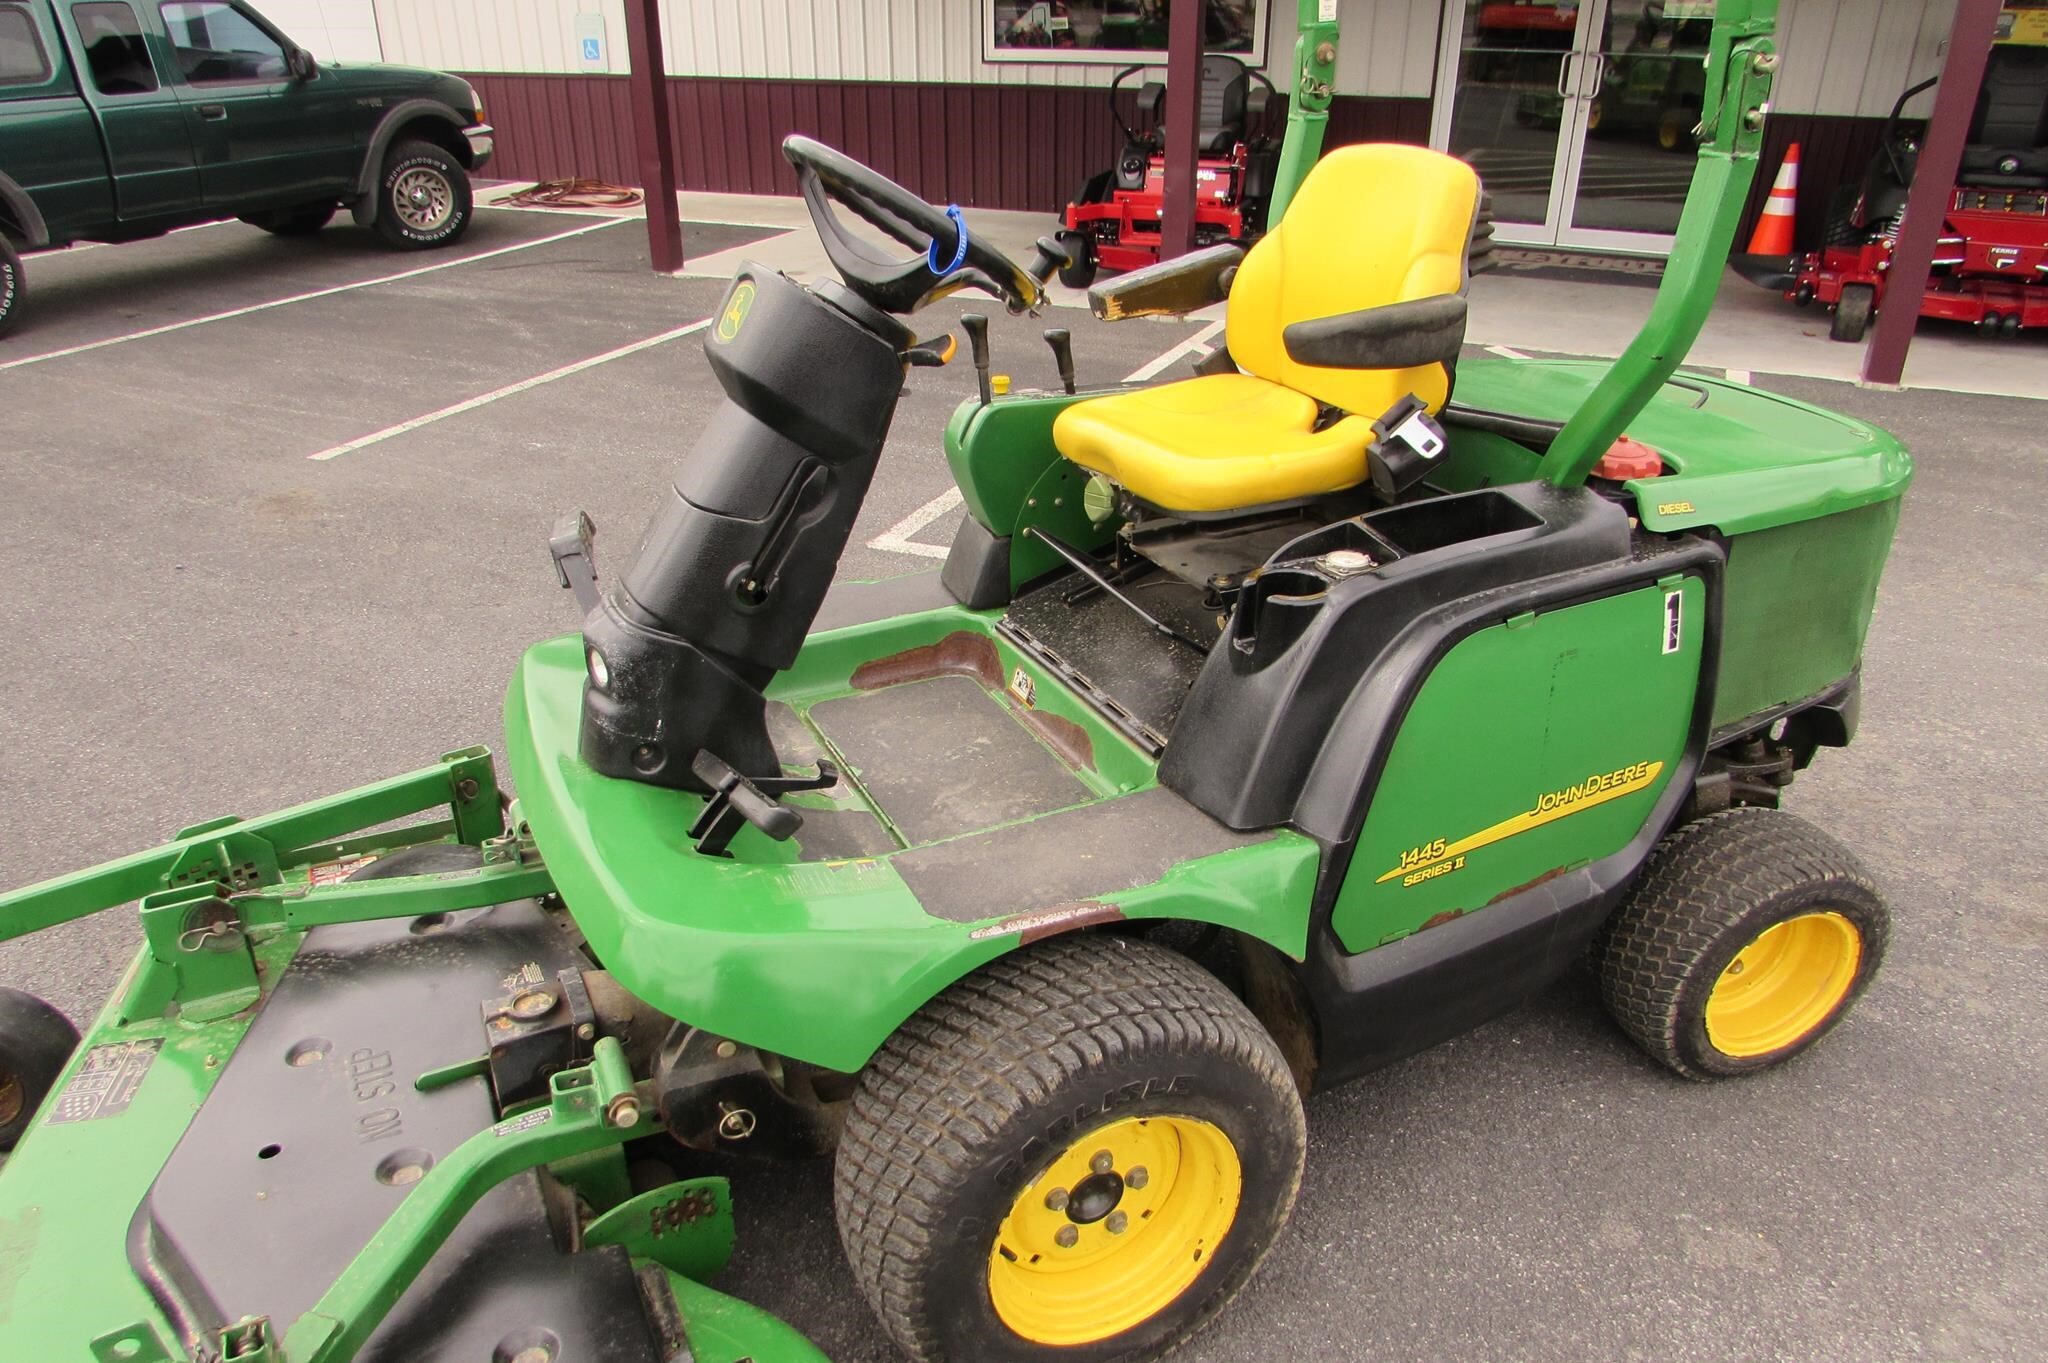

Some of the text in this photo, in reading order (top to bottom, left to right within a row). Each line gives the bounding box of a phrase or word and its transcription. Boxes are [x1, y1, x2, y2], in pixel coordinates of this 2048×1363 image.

[1658, 502, 1695, 516] DIESEL
[1529, 760, 1649, 816] JOHN DEERE
[1400, 838, 1447, 868] 1445
[1402, 856, 1466, 887] SERIES II
[351, 1048, 403, 1145] NO STEP
